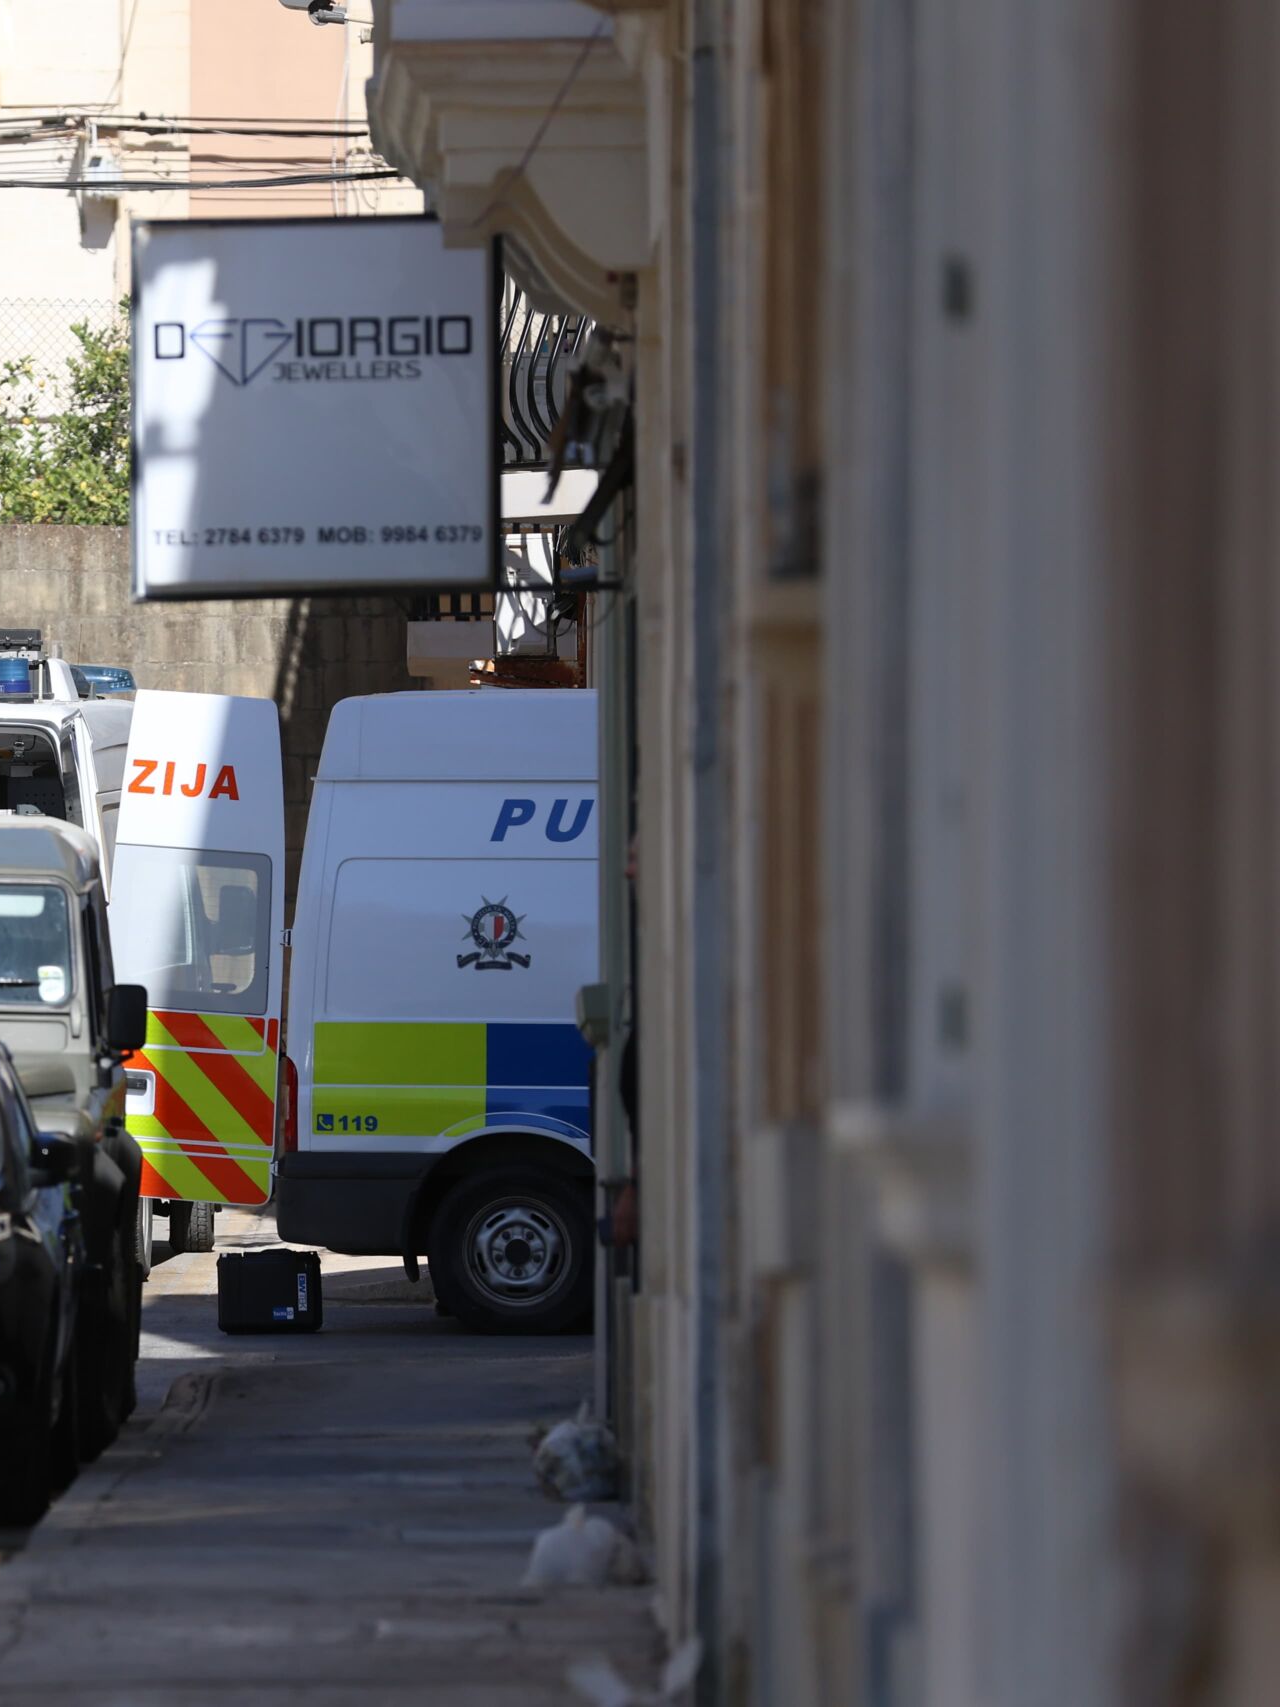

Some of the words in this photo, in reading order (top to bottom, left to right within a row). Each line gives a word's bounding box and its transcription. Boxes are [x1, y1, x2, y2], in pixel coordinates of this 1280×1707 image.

[272, 359, 423, 383] JEWELLERS
[152, 528, 199, 546] TEL:
[203, 527, 251, 546] 2784
[256, 527, 306, 545] 6379
[317, 526, 374, 545] MOB:
[379, 525, 428, 544] 9984
[434, 525, 484, 544] 6379
[127, 759, 240, 801] ZIJA
[489, 798, 596, 843] PU
[338, 1114, 379, 1132] 119
